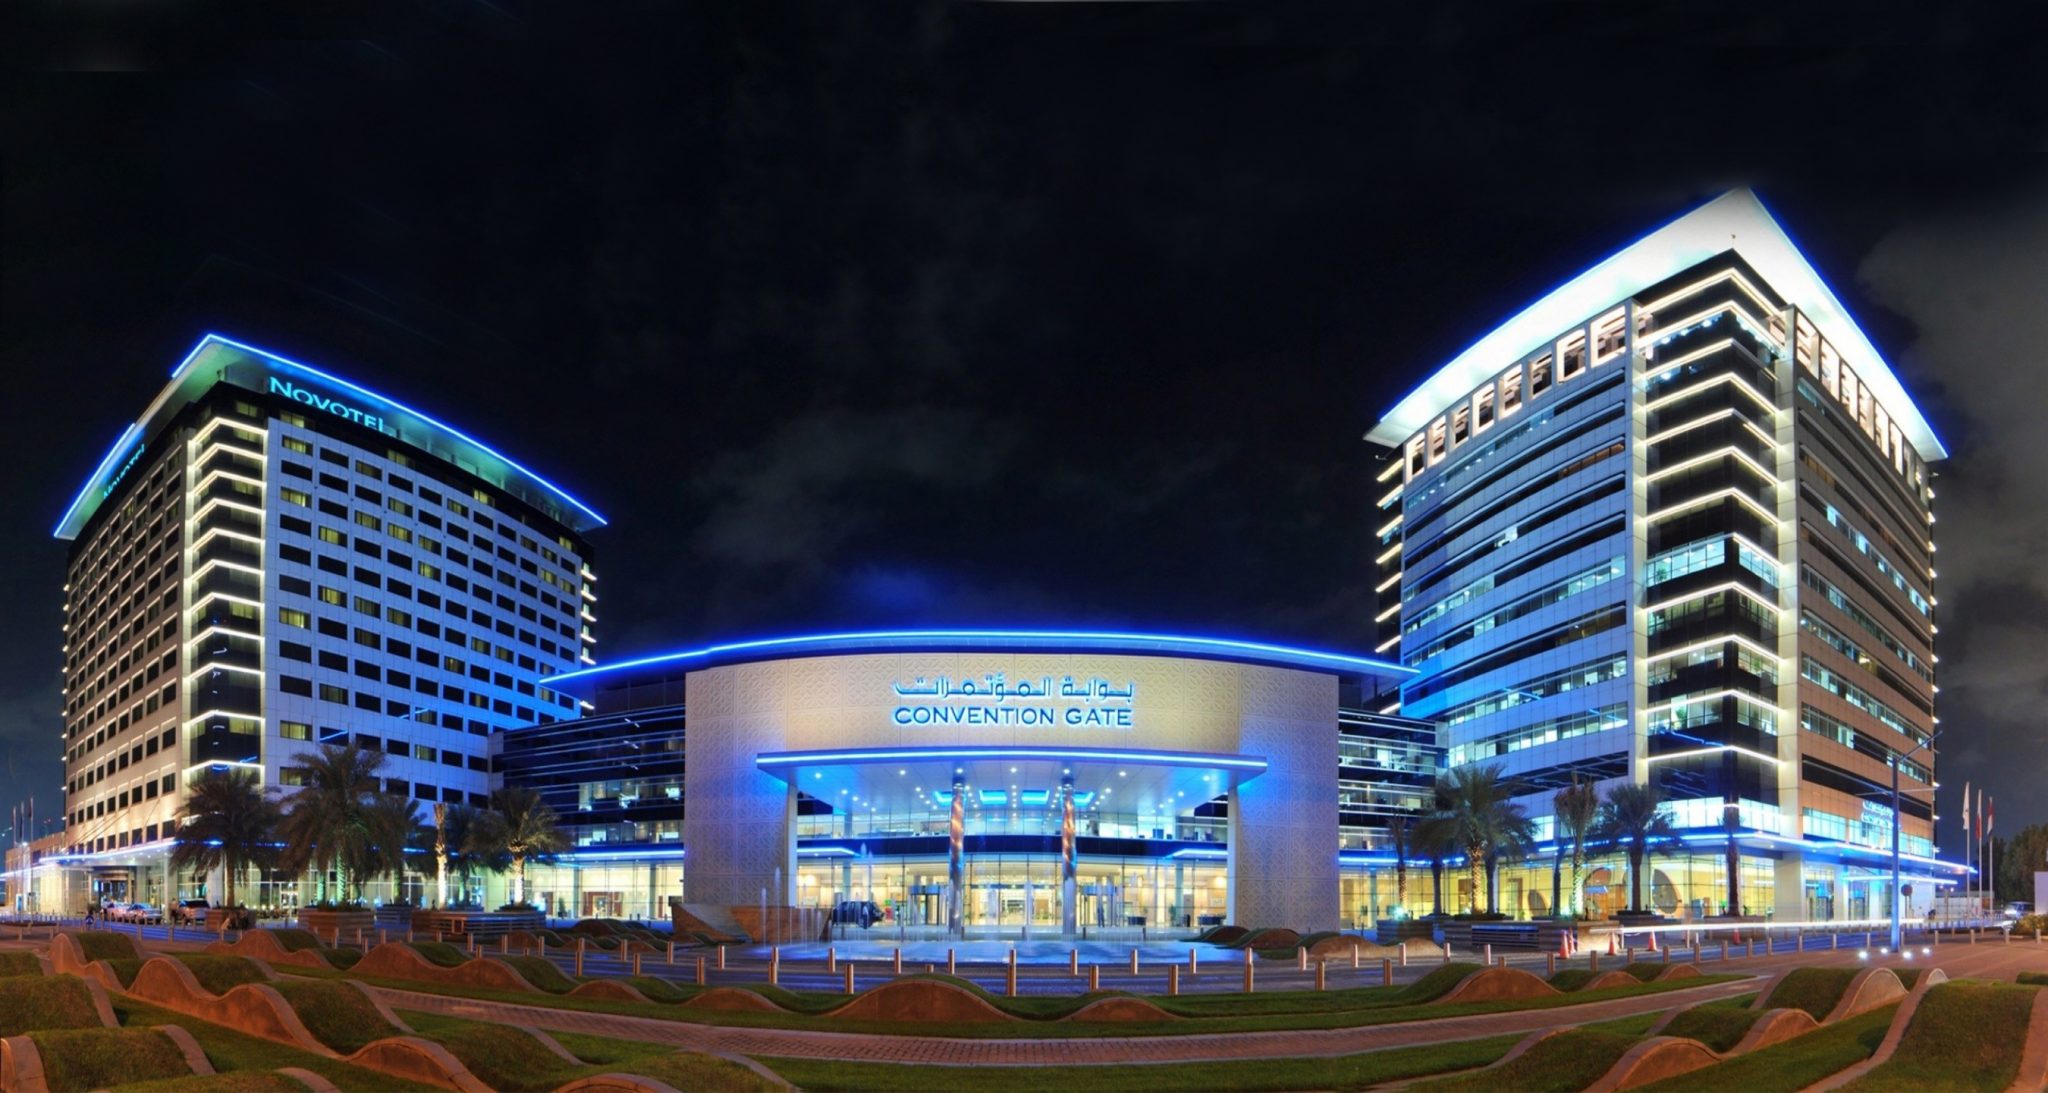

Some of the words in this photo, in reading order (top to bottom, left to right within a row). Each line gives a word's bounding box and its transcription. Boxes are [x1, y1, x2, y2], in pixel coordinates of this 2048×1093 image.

[894, 673, 1053, 703] المؤتمرات
[1061, 675, 1134, 703] بوابة
[894, 706, 1055, 726] CONVENTION
[1064, 707, 1133, 727] GATE
